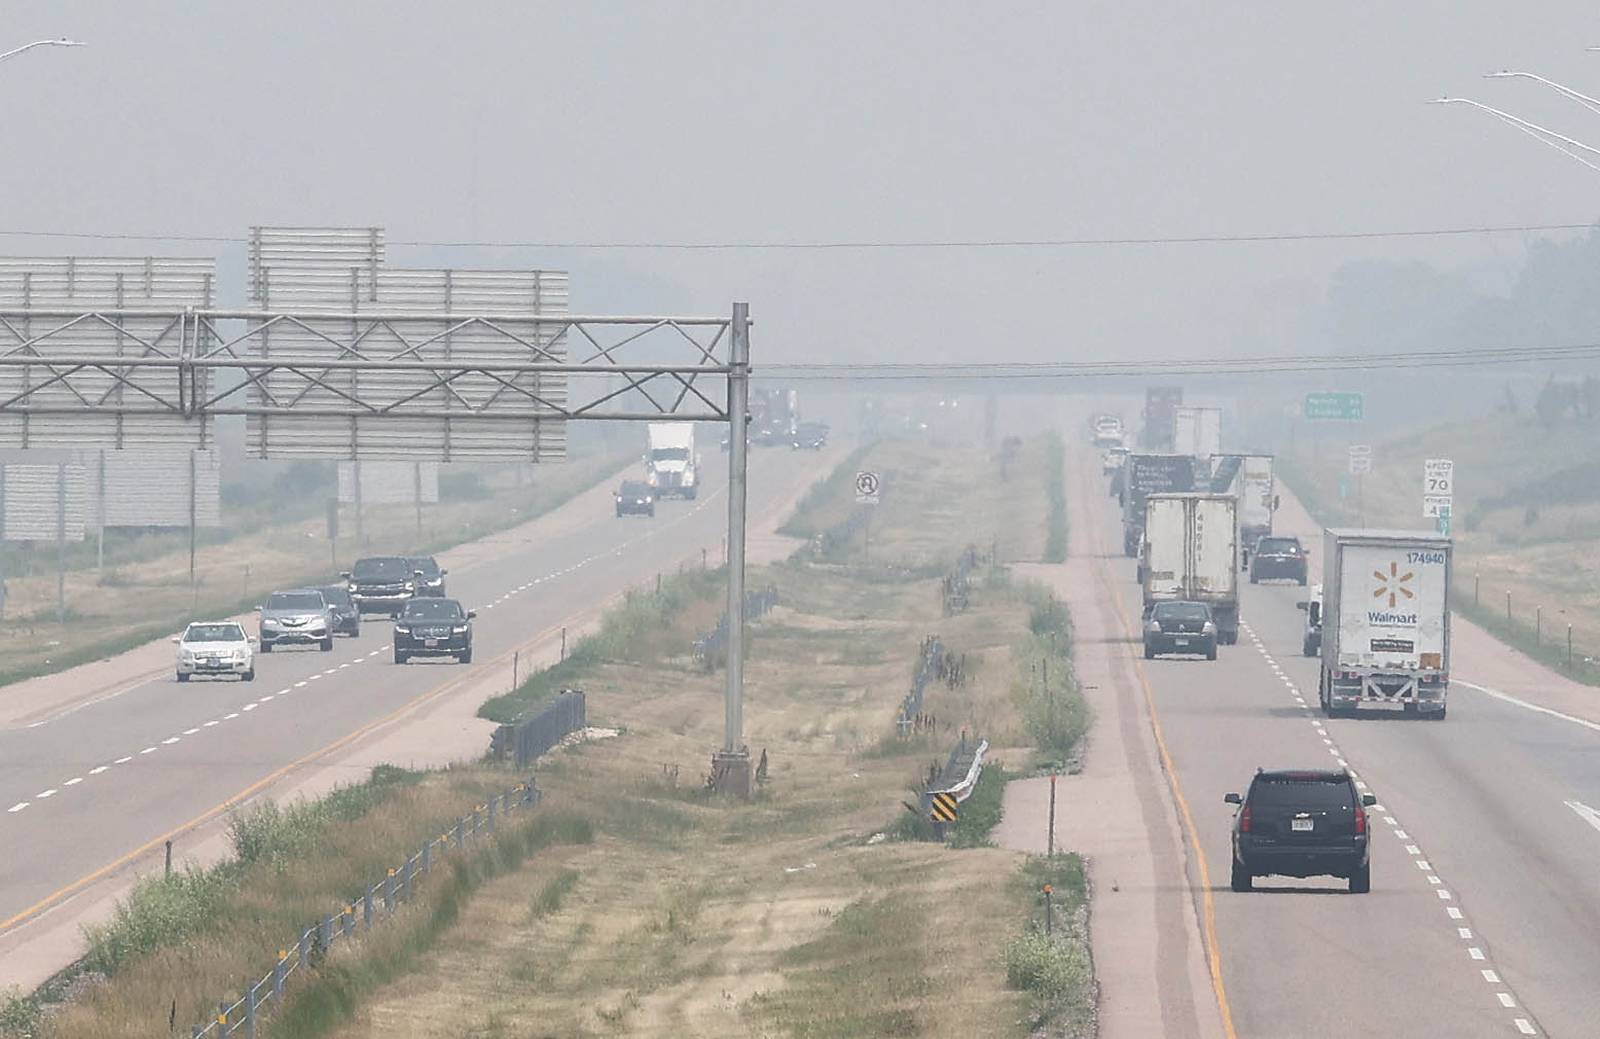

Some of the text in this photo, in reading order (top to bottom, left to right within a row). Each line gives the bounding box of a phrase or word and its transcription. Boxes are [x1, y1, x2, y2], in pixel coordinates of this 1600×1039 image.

[1429, 479, 1449, 491] 70
[1407, 552, 1445, 565] 174940
[1368, 612, 1418, 624] Walmart
